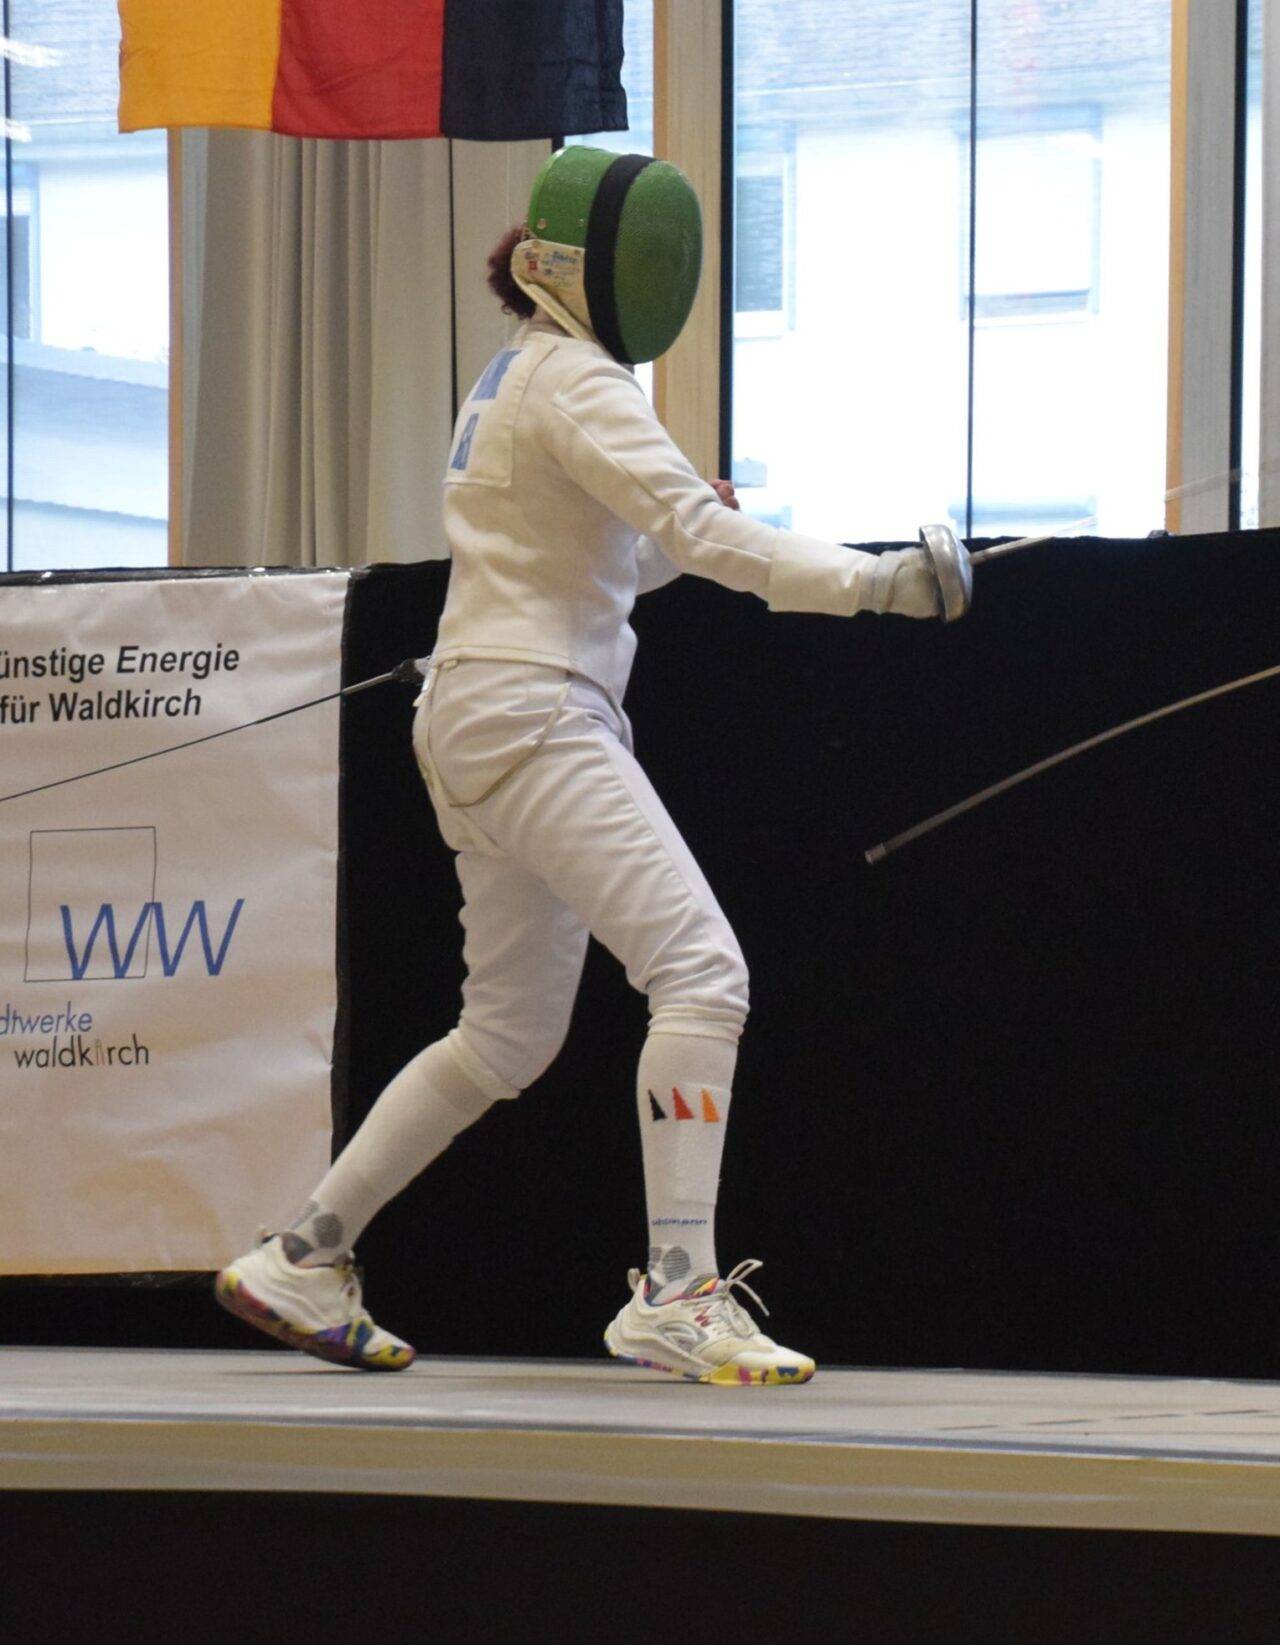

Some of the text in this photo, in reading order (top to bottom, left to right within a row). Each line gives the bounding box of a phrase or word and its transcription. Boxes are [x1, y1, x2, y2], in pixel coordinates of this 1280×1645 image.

[116, 643, 240, 680] Energie
[0, 688, 201, 724] für Waldkirch
[14, 1032, 150, 1068] waldkirch
